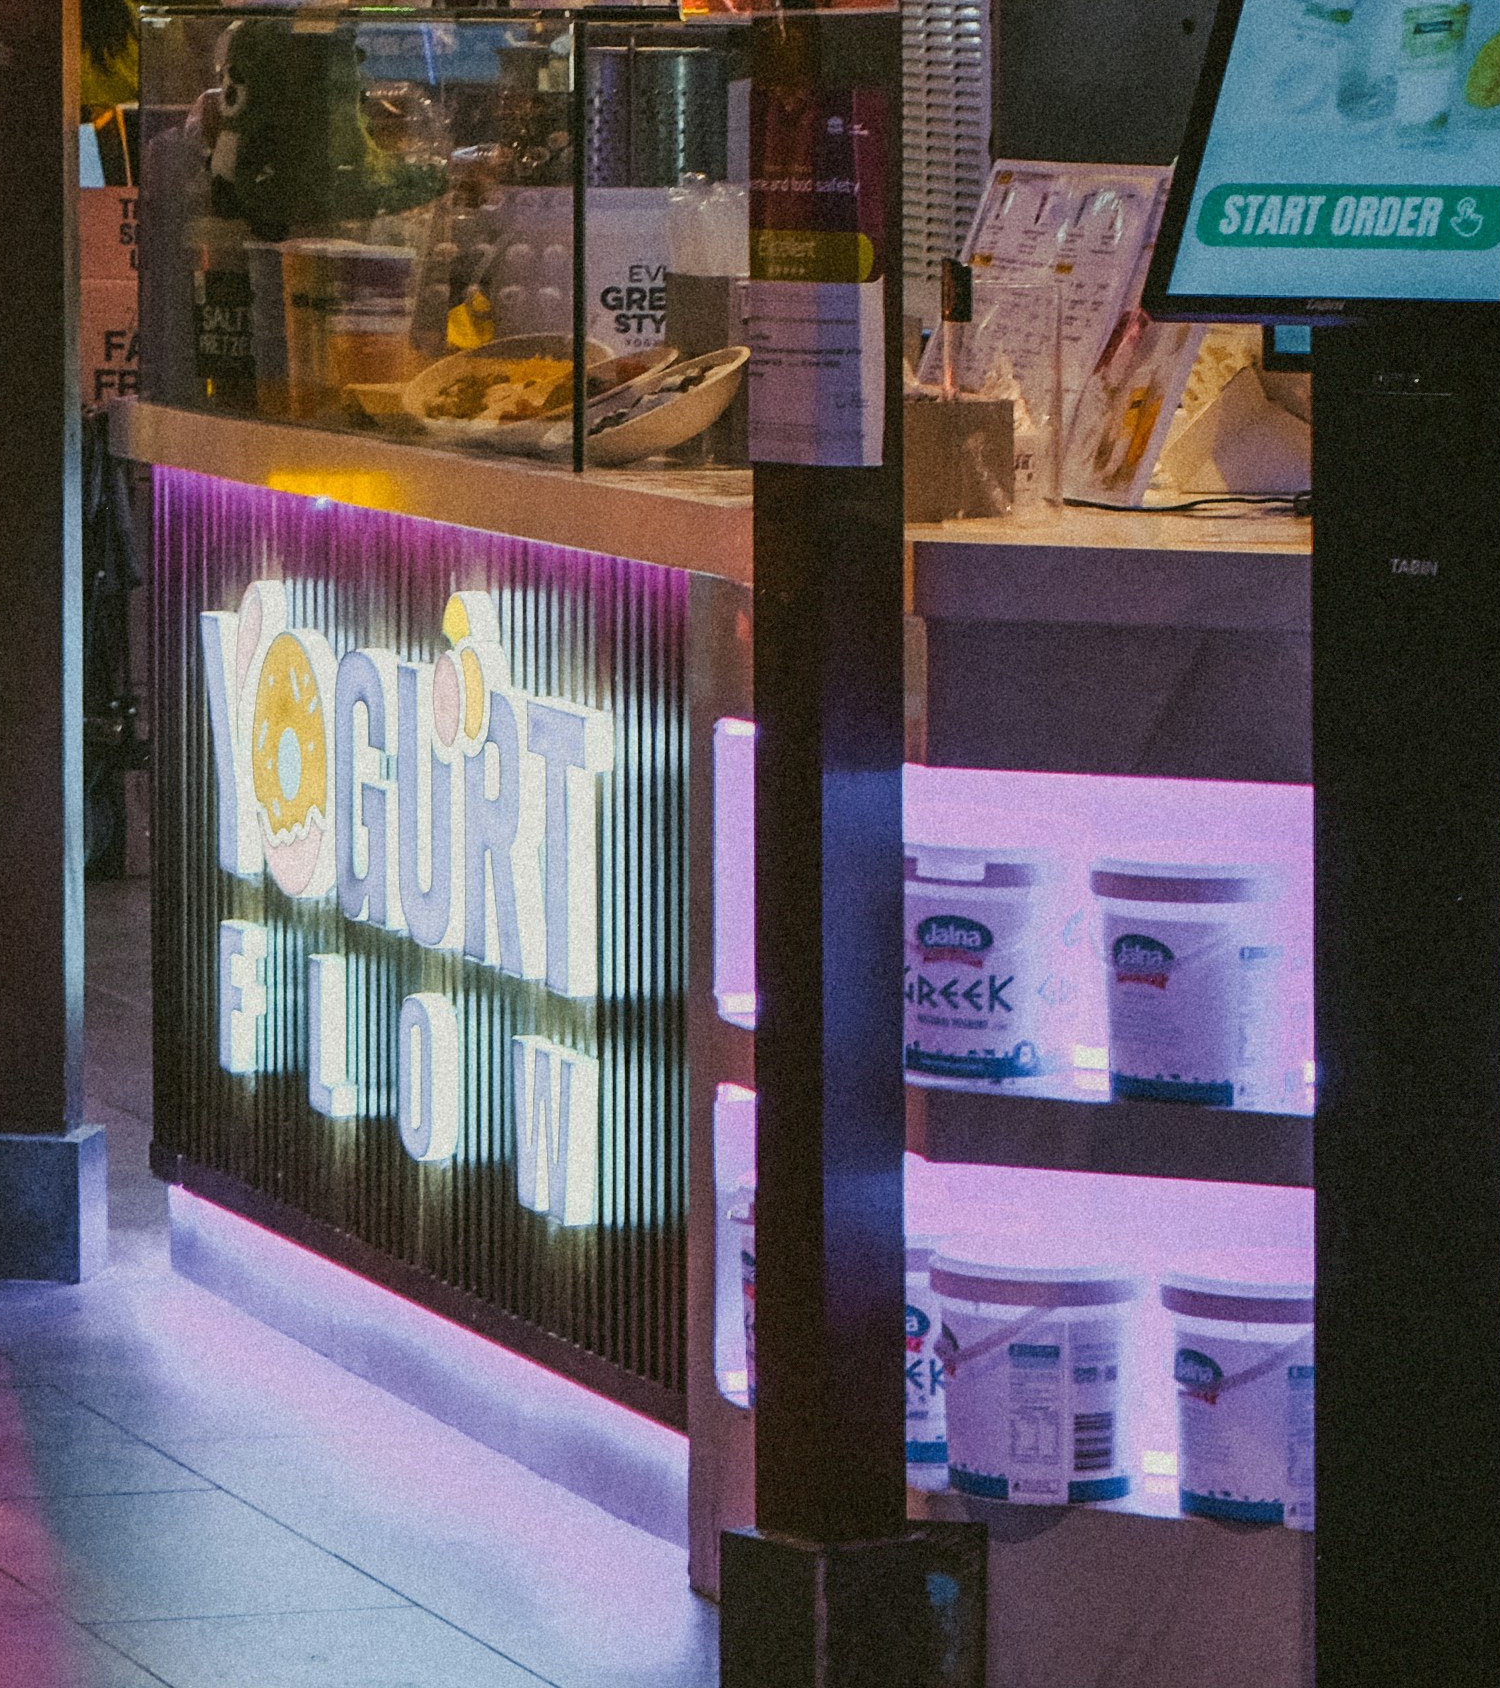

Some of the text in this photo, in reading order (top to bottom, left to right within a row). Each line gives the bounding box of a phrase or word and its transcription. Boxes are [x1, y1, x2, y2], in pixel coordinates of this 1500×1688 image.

[1219, 195, 1445, 238] START ORDER
[601, 286, 667, 310] GRE
[615, 313, 667, 334] STY
[200, 581, 613, 999] YOGURT
[219, 918, 600, 1228] FLOW
